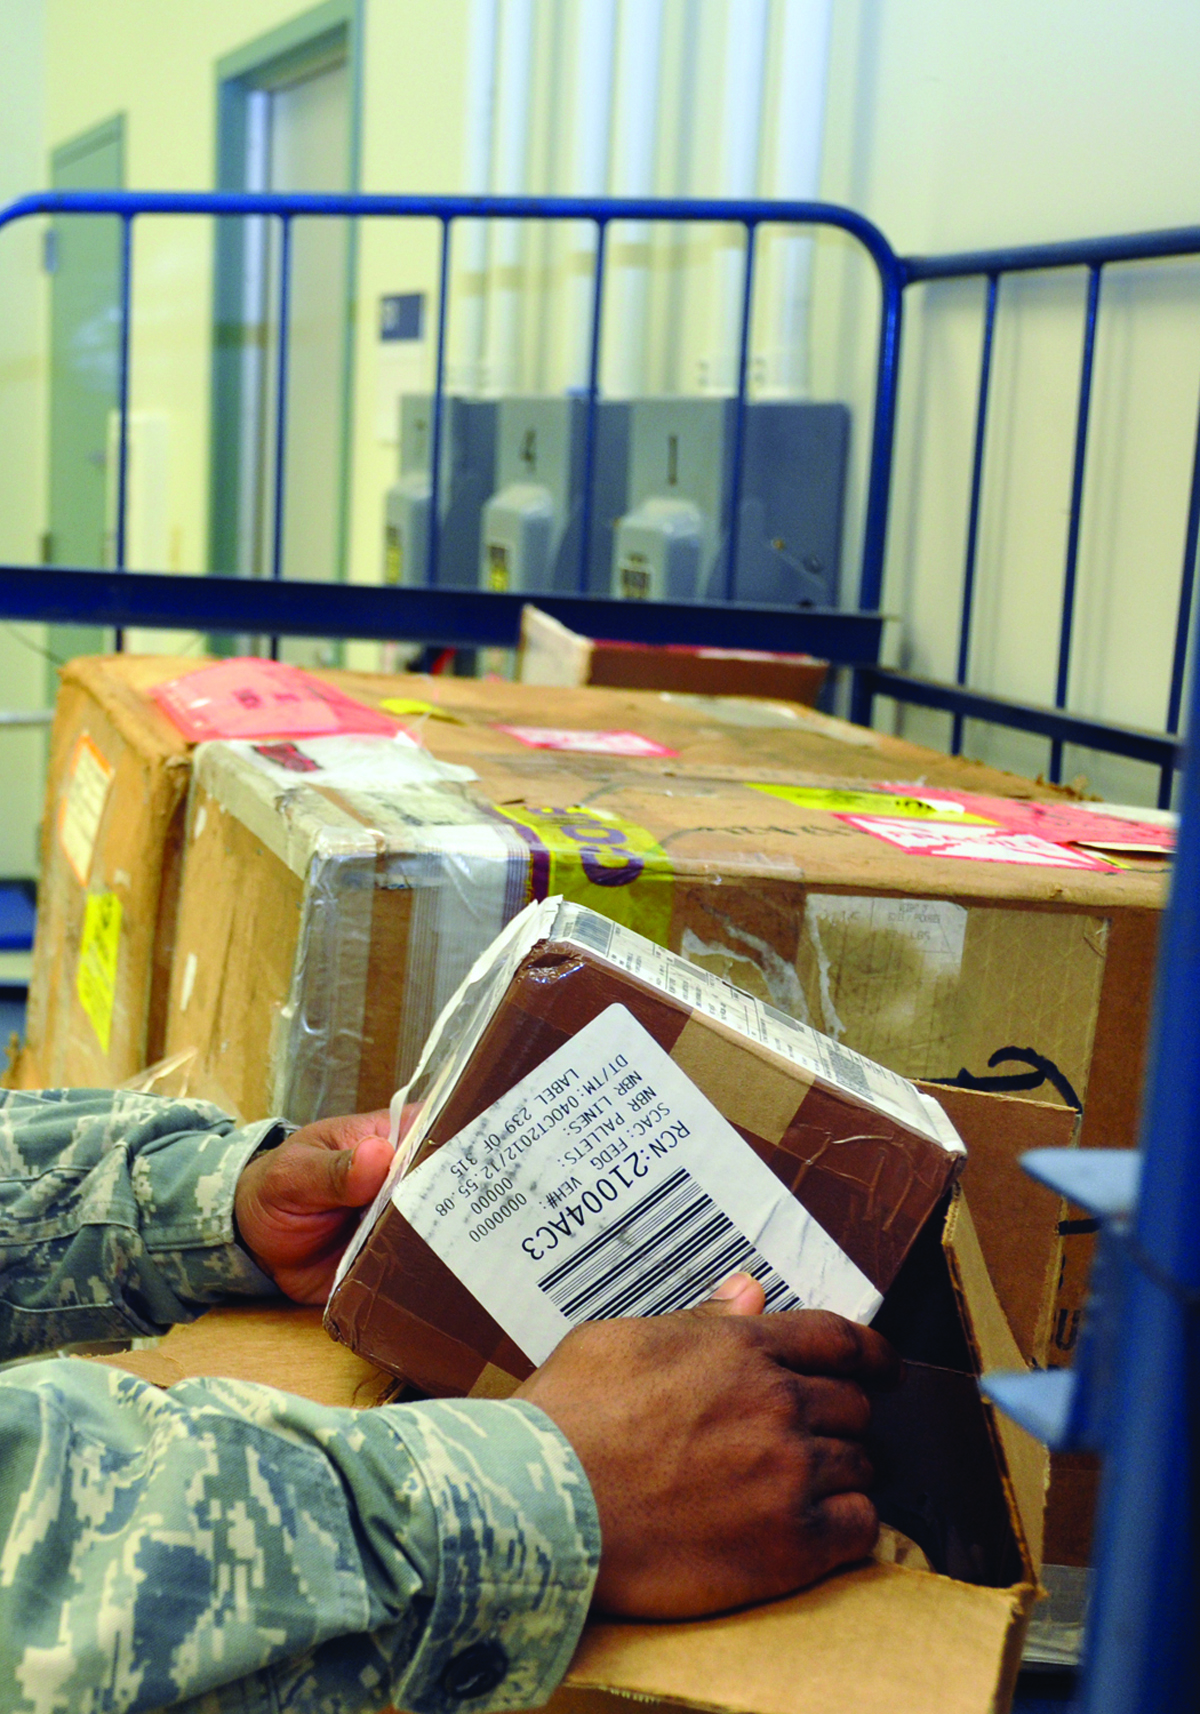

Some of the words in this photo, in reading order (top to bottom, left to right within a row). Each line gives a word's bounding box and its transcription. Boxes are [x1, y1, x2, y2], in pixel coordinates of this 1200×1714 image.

[533, 1067, 579, 1104] LABEL
[612, 1070, 642, 1096] NBR
[626, 1085, 657, 1112] NBR
[504, 1106, 532, 1134] 239
[562, 1095, 612, 1135] LINES:
[483, 1133, 501, 1154] OF
[557, 1111, 625, 1167] PALLETS:
[589, 1136, 628, 1170] FEDG
[449, 1152, 478, 1178] 315
[470, 1177, 513, 1214] 00000
[538, 1176, 582, 1209] VEH#:
[468, 1192, 527, 1242] 0000000
